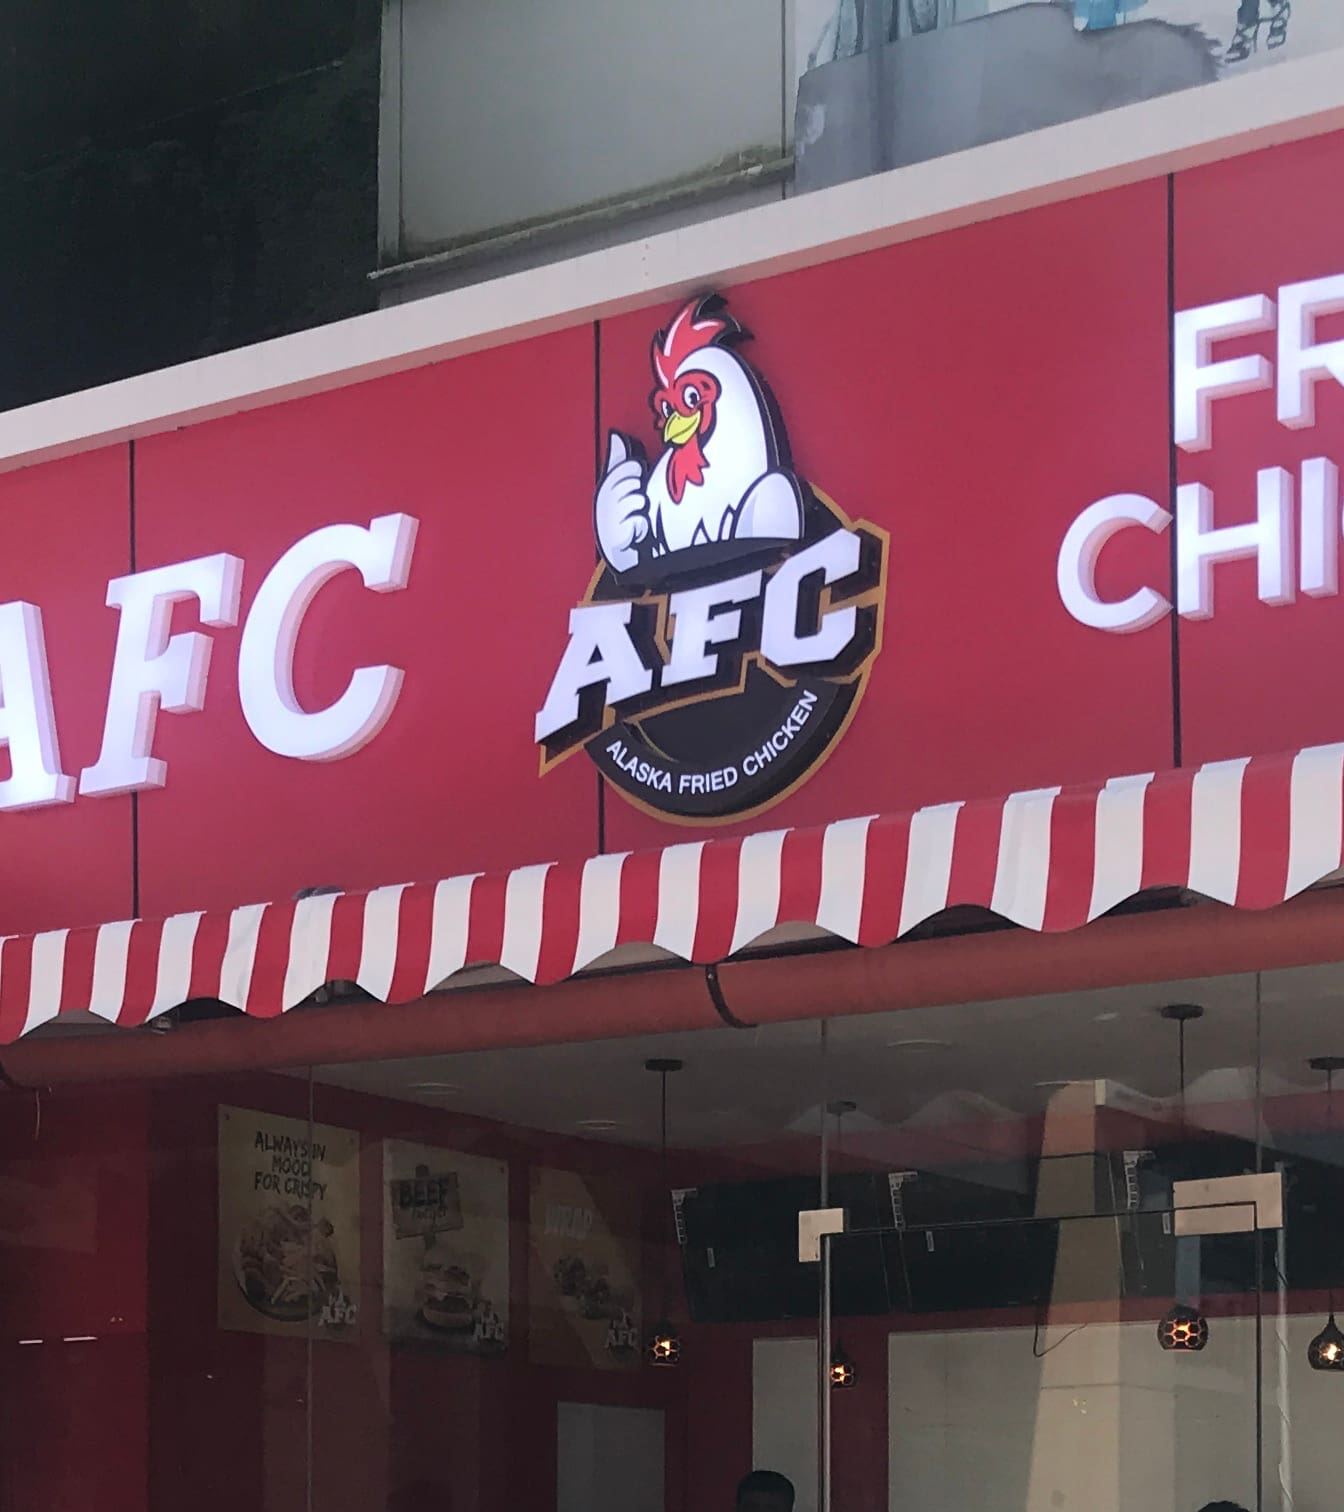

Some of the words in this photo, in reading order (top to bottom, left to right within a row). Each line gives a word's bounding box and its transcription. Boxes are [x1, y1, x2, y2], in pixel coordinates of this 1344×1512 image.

[535, 527, 862, 744] AFC
[606, 740, 672, 793] ALASKA
[678, 766, 739, 794] FRIED
[742, 690, 819, 777] CHICKEN
[254, 1130, 309, 1159] ALWAYS
[312, 1143, 327, 1162] IN
[272, 1155, 310, 1177] MOOD
[254, 1171, 281, 1195] FOR
[284, 1176, 328, 1201] CRISPY
[604, 1327, 637, 1349] AFC
